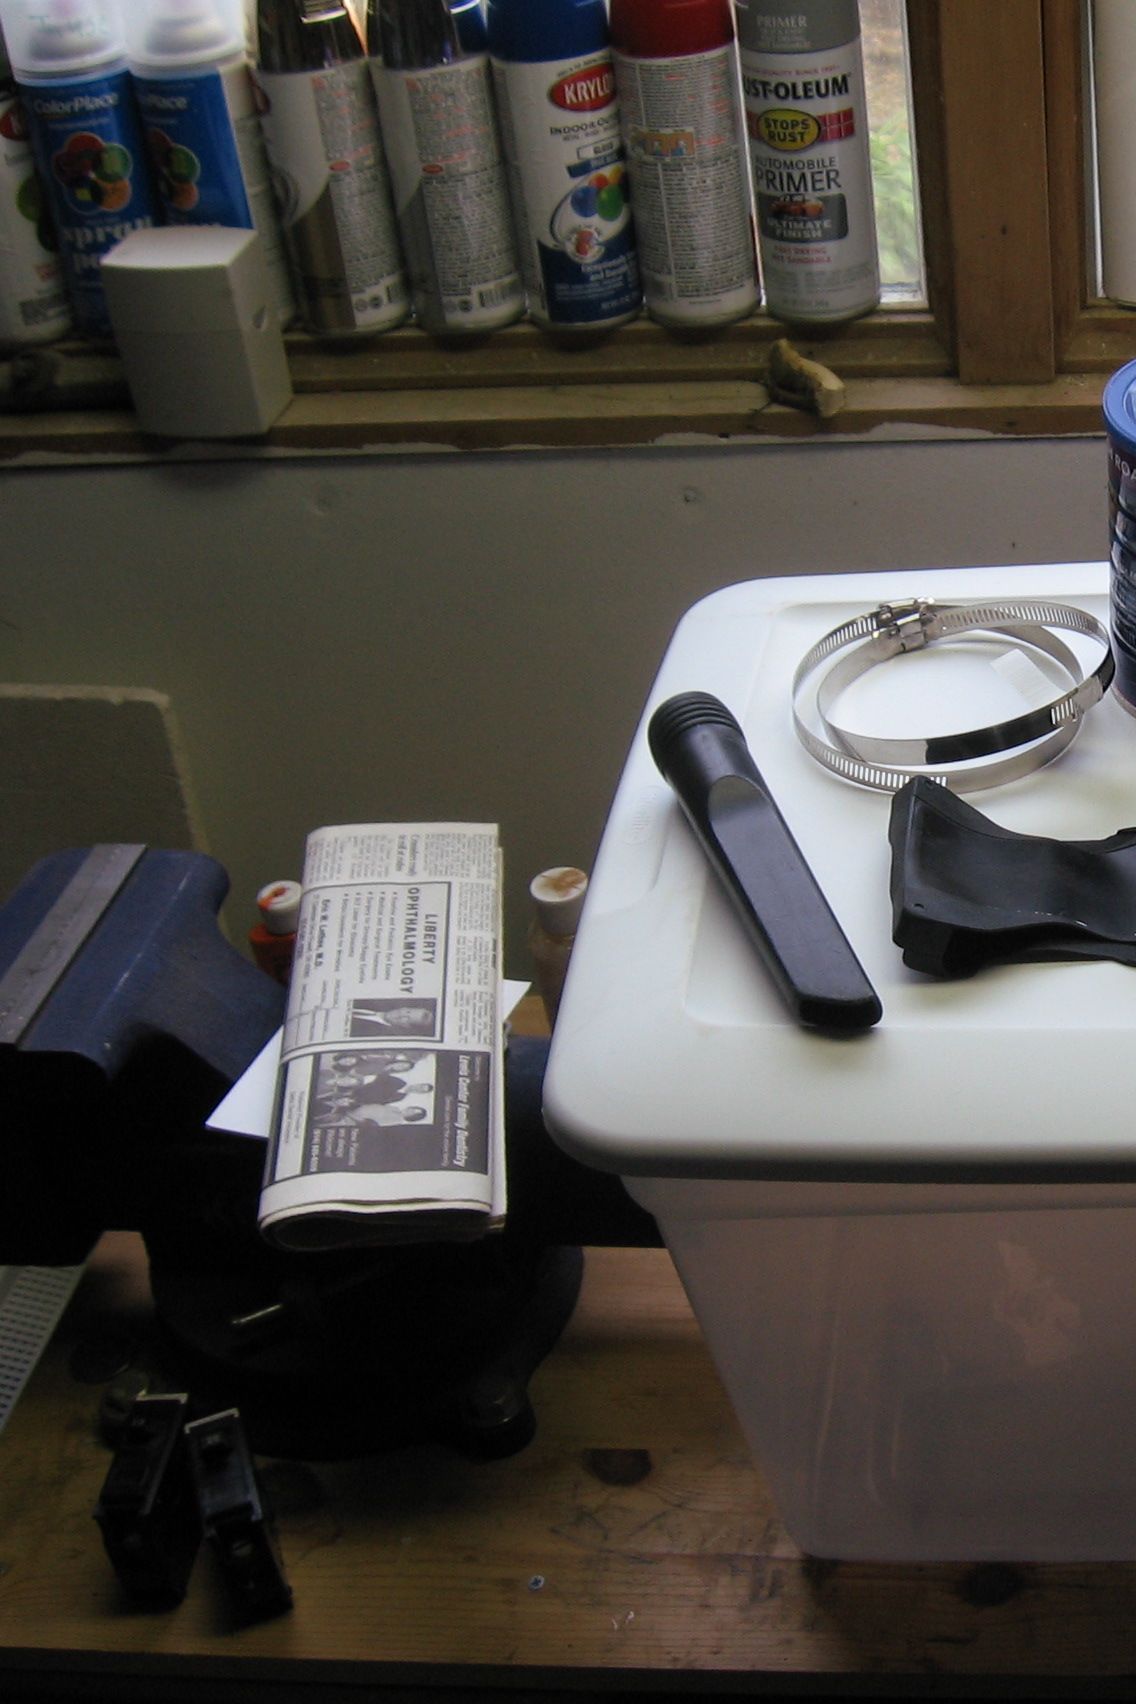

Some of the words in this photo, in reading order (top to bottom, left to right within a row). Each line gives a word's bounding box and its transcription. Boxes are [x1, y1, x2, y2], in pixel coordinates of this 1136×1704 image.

[757, 15, 807, 28] PRIMER
[742, 73, 850, 100] UST-OLEUM
[765, 118, 810, 130] STOPS
[768, 130, 807, 142] RUST
[755, 156, 837, 170] AUTOMOBILE
[756, 166, 842, 193] PRIMER
[400, 887, 420, 994] OPHTHALMOLOGY
[422, 914, 438, 964] LIBERTY
